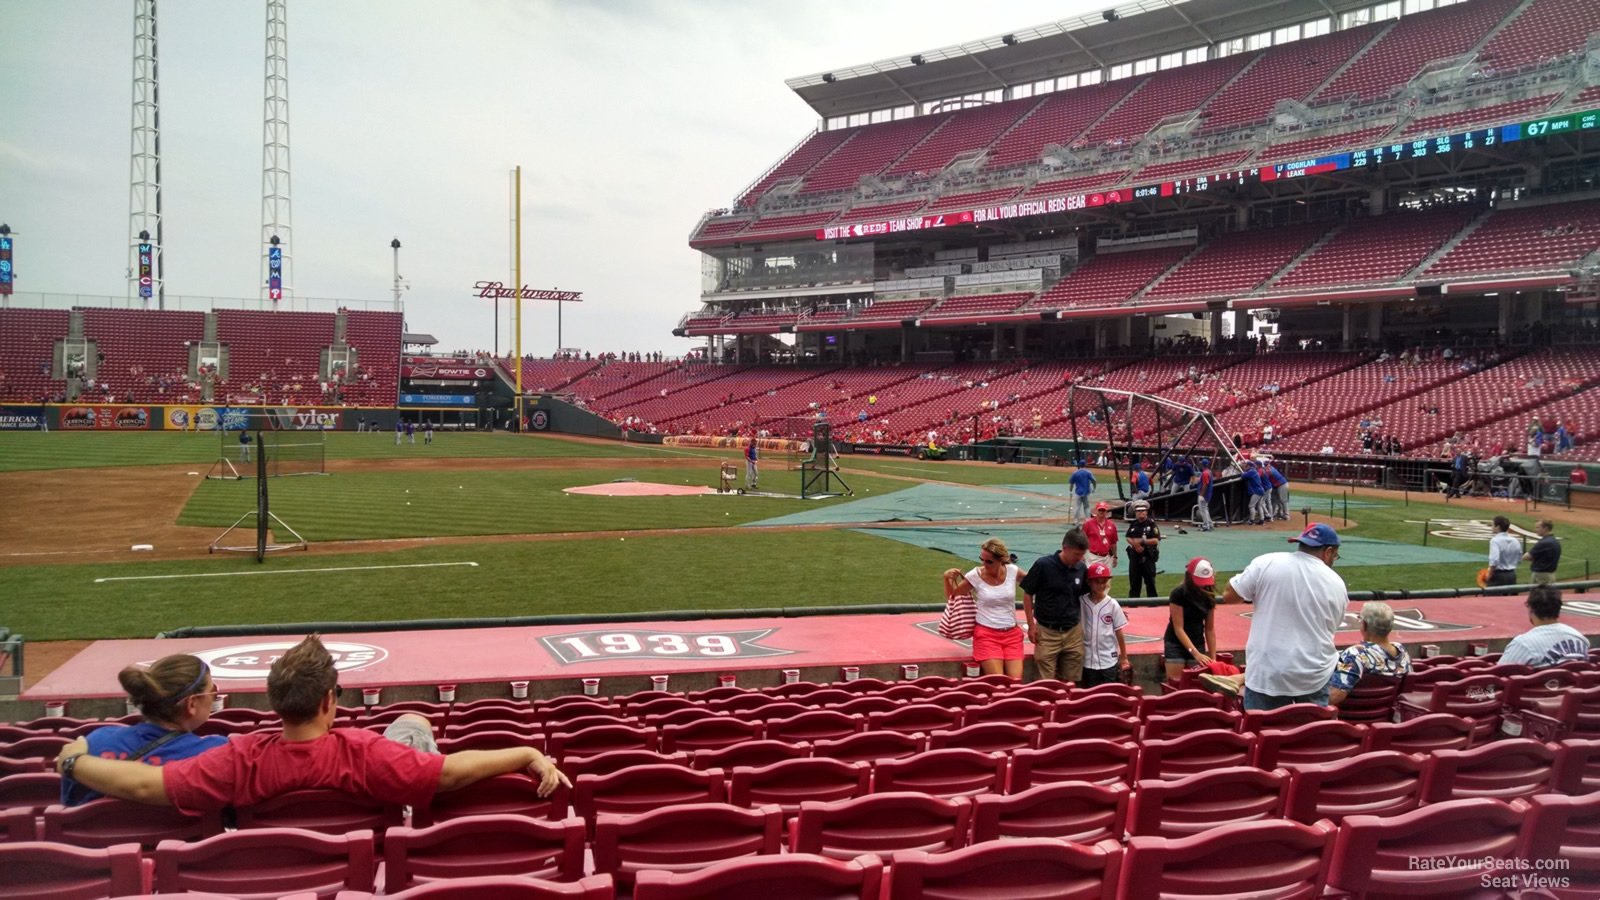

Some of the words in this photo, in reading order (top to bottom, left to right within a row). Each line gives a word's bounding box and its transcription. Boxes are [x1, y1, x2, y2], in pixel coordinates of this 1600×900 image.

[1528, 121, 1548, 136] 67
[1551, 121, 1569, 130] MPH
[1353, 150, 1366, 159] AVG
[1374, 147, 1383, 156] HR
[1391, 144, 1403, 153] RBI
[1412, 140, 1427, 149] OBP
[1436, 136, 1450, 145] SLG
[1465, 132, 1472, 140] R
[1487, 128, 1494, 136] H
[1353, 158, 1367, 167] .229
[1395, 152, 1401, 160] 7
[1435, 144, 1451, 154] .356
[1464, 140, 1473, 149] 16
[1485, 136, 1495, 146] 27
[1287, 159, 1316, 171] COGHLAN
[1287, 168, 1306, 178] LEAKE
[1196, 176, 1208, 184] ERA
[1226, 172, 1232, 180] S
[1250, 168, 1259, 176] PC
[1135, 187, 1157, 197] 6:01:46
[1195, 183, 1208, 192] 3.47
[973, 209, 987, 223] FOR
[987, 207, 999, 221] ALL
[1000, 204, 1018, 219] YOUR
[1018, 200, 1048, 217] OFFICIAL
[1048, 198, 1066, 213] REDS
[1066, 195, 1086, 210] GEAR
[824, 227, 839, 240] VISIT
[839, 225, 851, 238] THE
[862, 222, 888, 234] REDS
[889, 219, 906, 232] TEAM
[906, 217, 923, 231] SHOP
[924, 219, 932, 229] BY
[473, 281, 583, 301] Budweiser
[264, 408, 339, 430] Wyler
[561, 632, 738, 657] 1939
